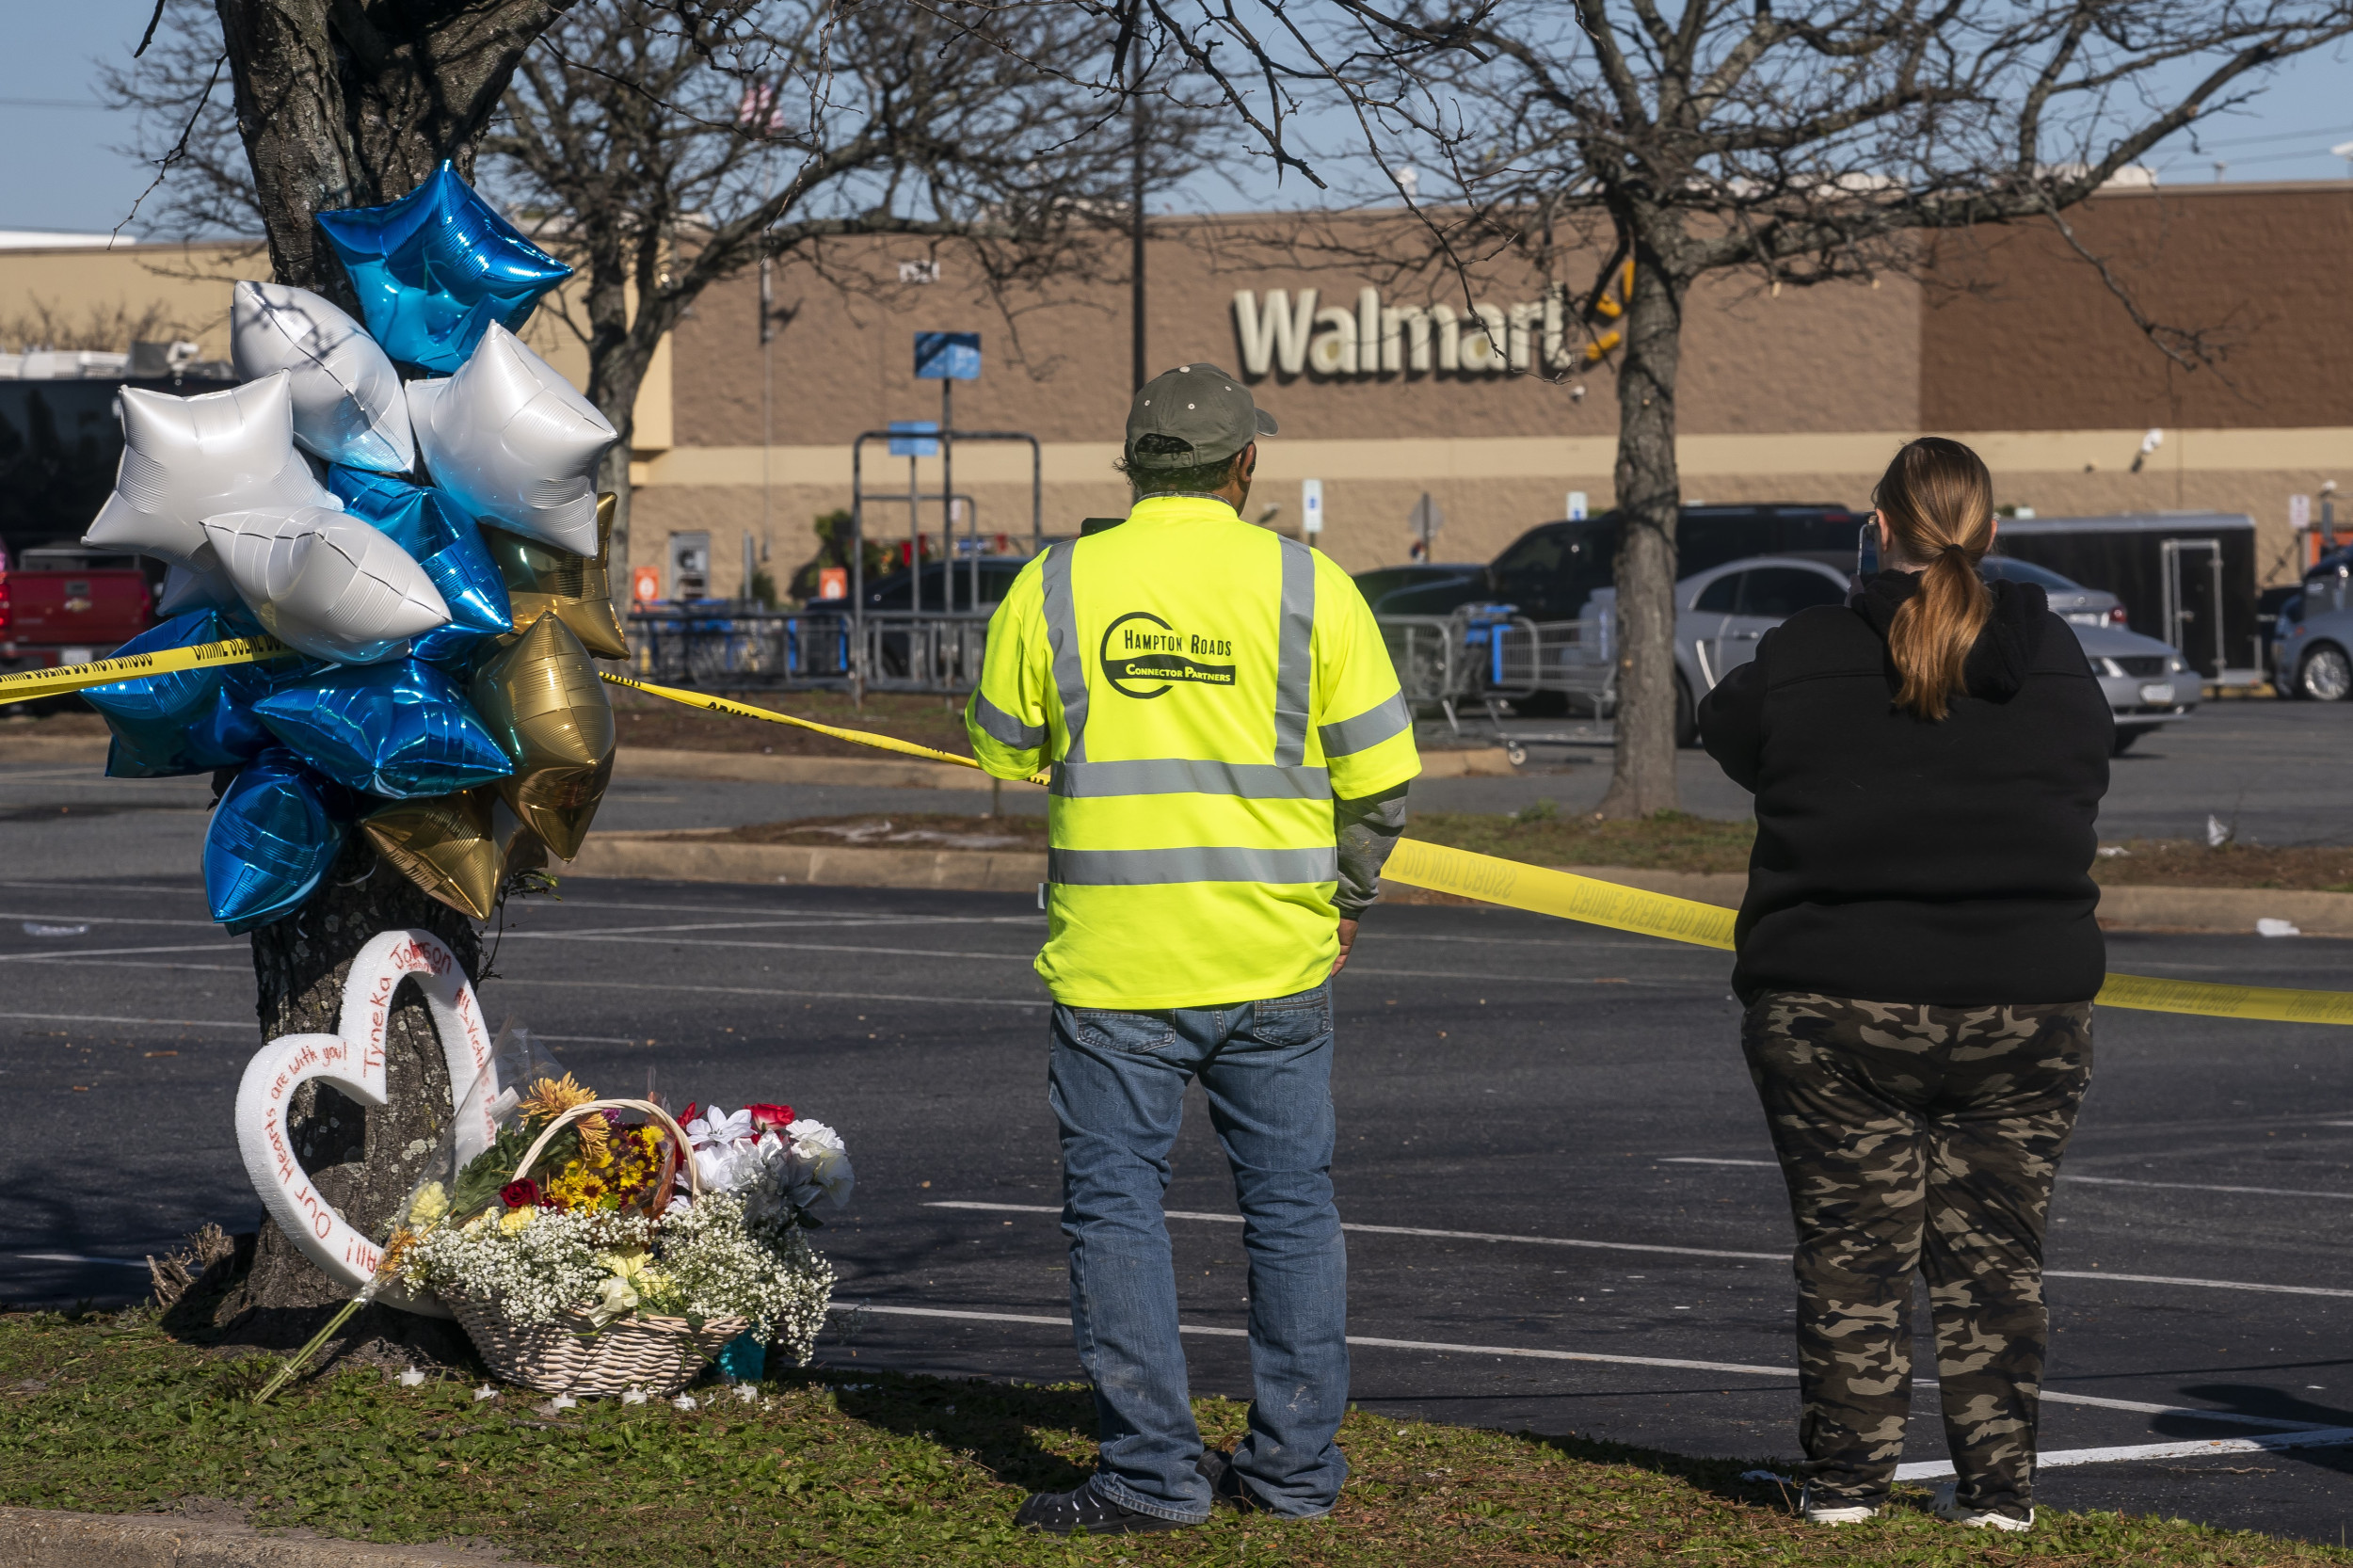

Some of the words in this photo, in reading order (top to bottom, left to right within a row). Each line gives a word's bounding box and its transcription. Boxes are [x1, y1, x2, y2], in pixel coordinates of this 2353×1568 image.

[1233, 280, 1571, 375] Walmart
[1125, 630, 1183, 652] HAMPTON
[1191, 634, 1232, 656] ROADS
[1125, 664, 1184, 678] CONNECTOR
[1184, 666, 1231, 681] PARTNERS
[294, 1186, 331, 1239] Our
[322, 1042, 346, 1070] you!
